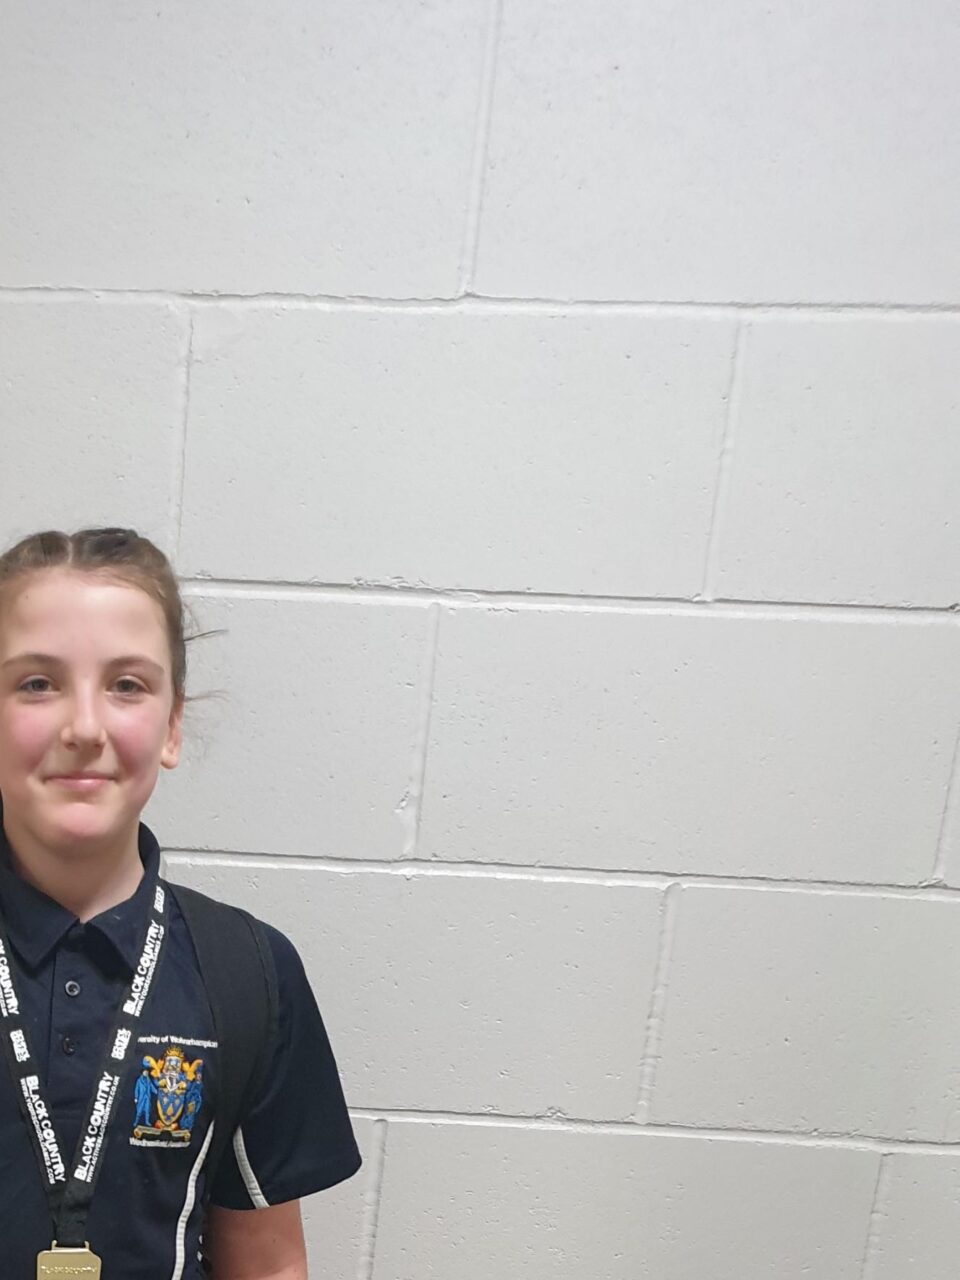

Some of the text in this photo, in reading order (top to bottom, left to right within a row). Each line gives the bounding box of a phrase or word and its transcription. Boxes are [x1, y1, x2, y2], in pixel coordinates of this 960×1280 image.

[122, 972, 145, 1015] BLACK
[137, 919, 161, 974] COUNTRY
[26, 1075, 66, 1182] BLACK COUNTRY
[74, 1071, 113, 1181] BLACK COUNTRY
